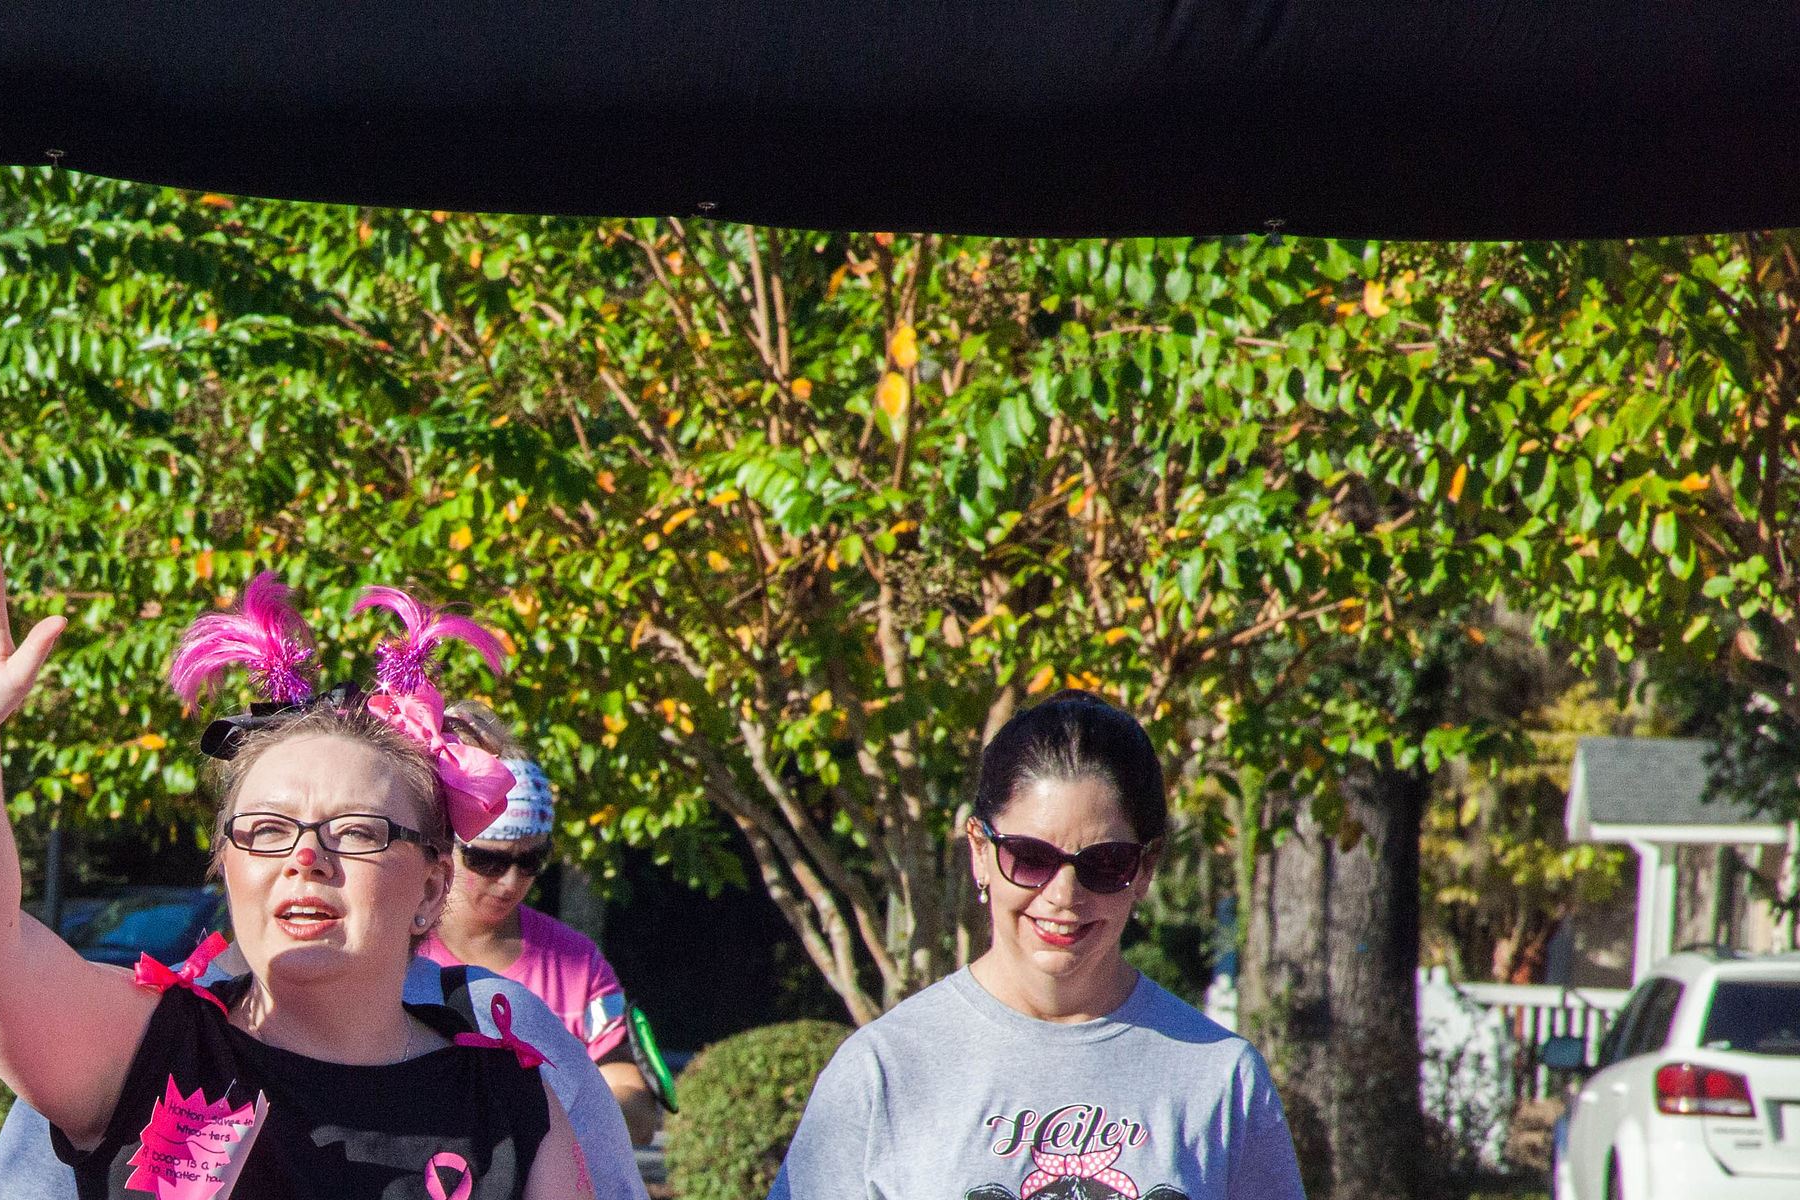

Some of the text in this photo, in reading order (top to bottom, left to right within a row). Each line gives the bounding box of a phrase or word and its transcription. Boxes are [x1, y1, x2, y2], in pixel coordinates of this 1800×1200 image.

[986, 1104, 1148, 1157] Heifer
[148, 1165, 161, 1174] no
[165, 1167, 201, 1182] matter
